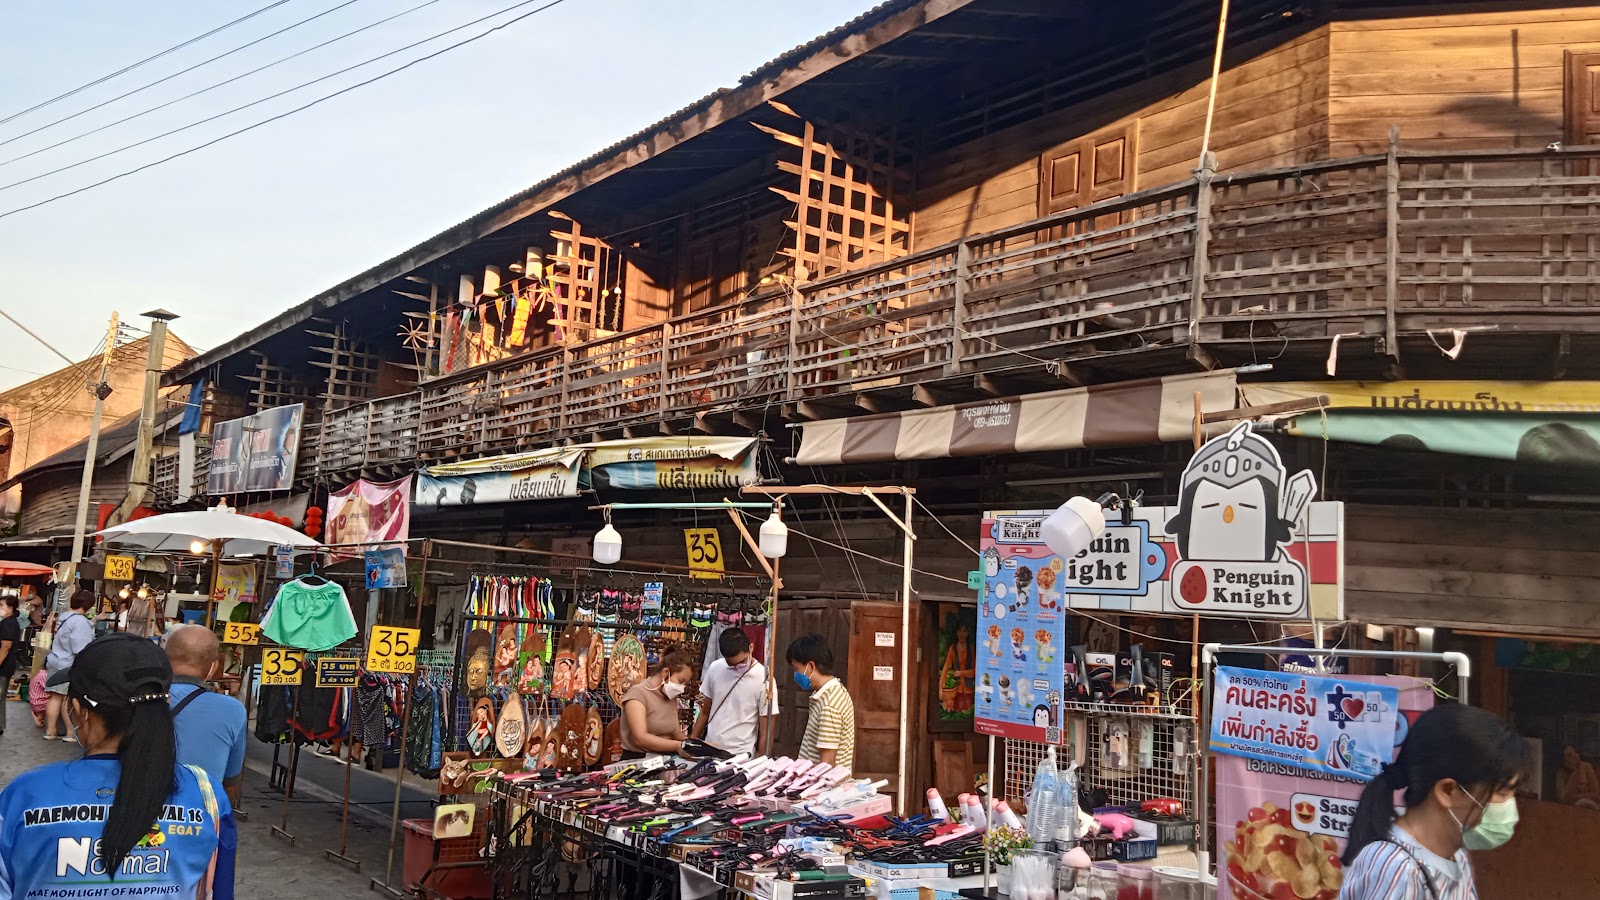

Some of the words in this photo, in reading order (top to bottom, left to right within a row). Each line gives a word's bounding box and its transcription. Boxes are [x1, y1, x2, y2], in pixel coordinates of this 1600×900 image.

[509, 474, 566, 500] เปลี่ยนเป็น
[690, 533, 719, 563] 35
[1068, 559, 1127, 585] ight
[1212, 568, 1295, 588] Penguin
[1212, 588, 1293, 608] Knight
[321, 662, 336, 670] 35
[339, 662, 355, 670] บาท
[370, 658, 377, 668] 3
[1120, 658, 1133, 666] CK
[266, 675, 272, 684] 3
[273, 674, 283, 684] ตัว
[1229, 676, 1241, 685] ลด
[1242, 677, 1262, 687] 50%
[1263, 675, 1289, 691] ทั่วไทย
[1226, 680, 1317, 717] คนละครึ่ง
[1333, 711, 1345, 720] 50
[1366, 703, 1378, 712] 50
[1220, 711, 1320, 752] เพิ่มกำลังซื้อ
[24, 804, 105, 828] MAEMOH
[188, 808, 203, 824] 16
[1319, 798, 1357, 817] Sass
[168, 824, 202, 836] EGAT
[27, 888, 49, 898] MAE
[50, 888, 75, 898] MOH
[77, 887, 110, 897] LIGHT
[112, 886, 126, 896] OF
[128, 884, 181, 896] HAPPINESS
